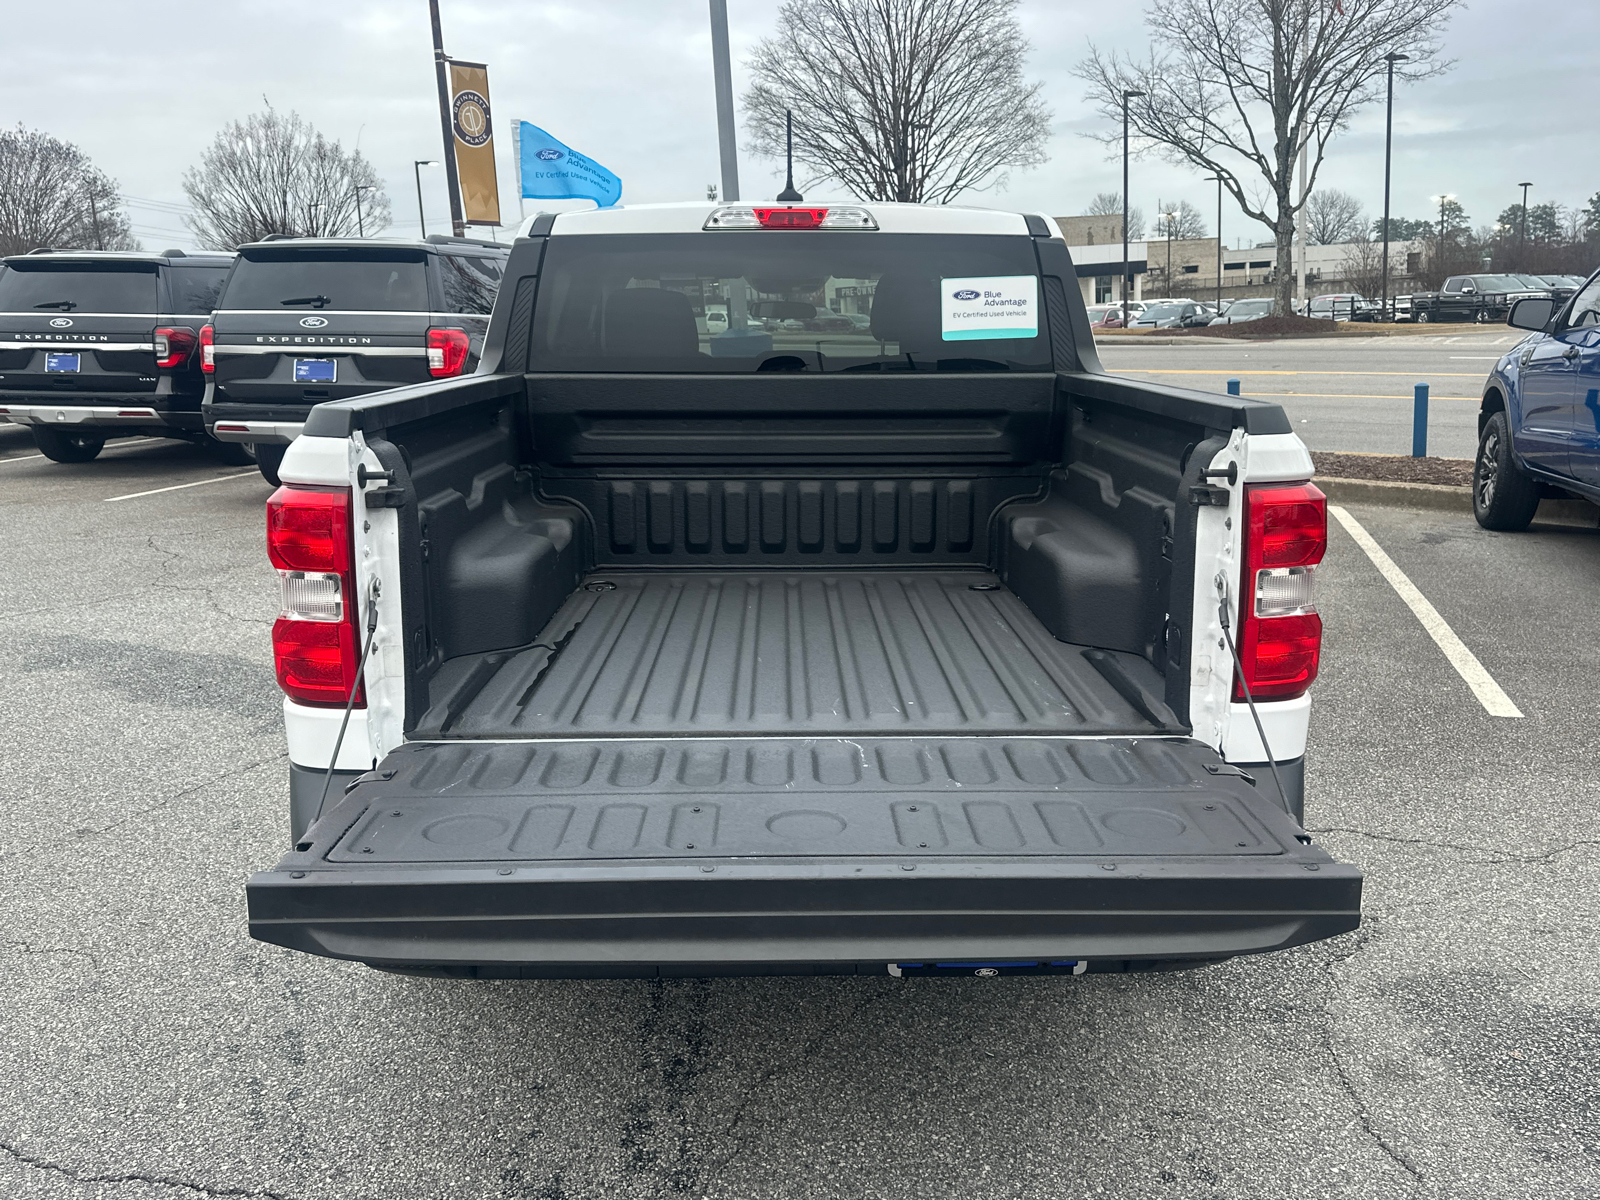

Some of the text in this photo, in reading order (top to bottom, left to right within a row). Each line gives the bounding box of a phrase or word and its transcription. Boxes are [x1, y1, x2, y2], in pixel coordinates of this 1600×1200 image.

[453, 94, 487, 113] GWINNETT
[465, 132, 488, 143] PLACE
[568, 150, 587, 164] Blue
[566, 157, 611, 185] Advantage
[570, 172, 588, 182] Used
[589, 177, 610, 194] Vehicle
[841, 286, 876, 297] PRE-OWNE
[984, 298, 1027, 307] Advantage
[256, 336, 371, 344] EXPEDITION
